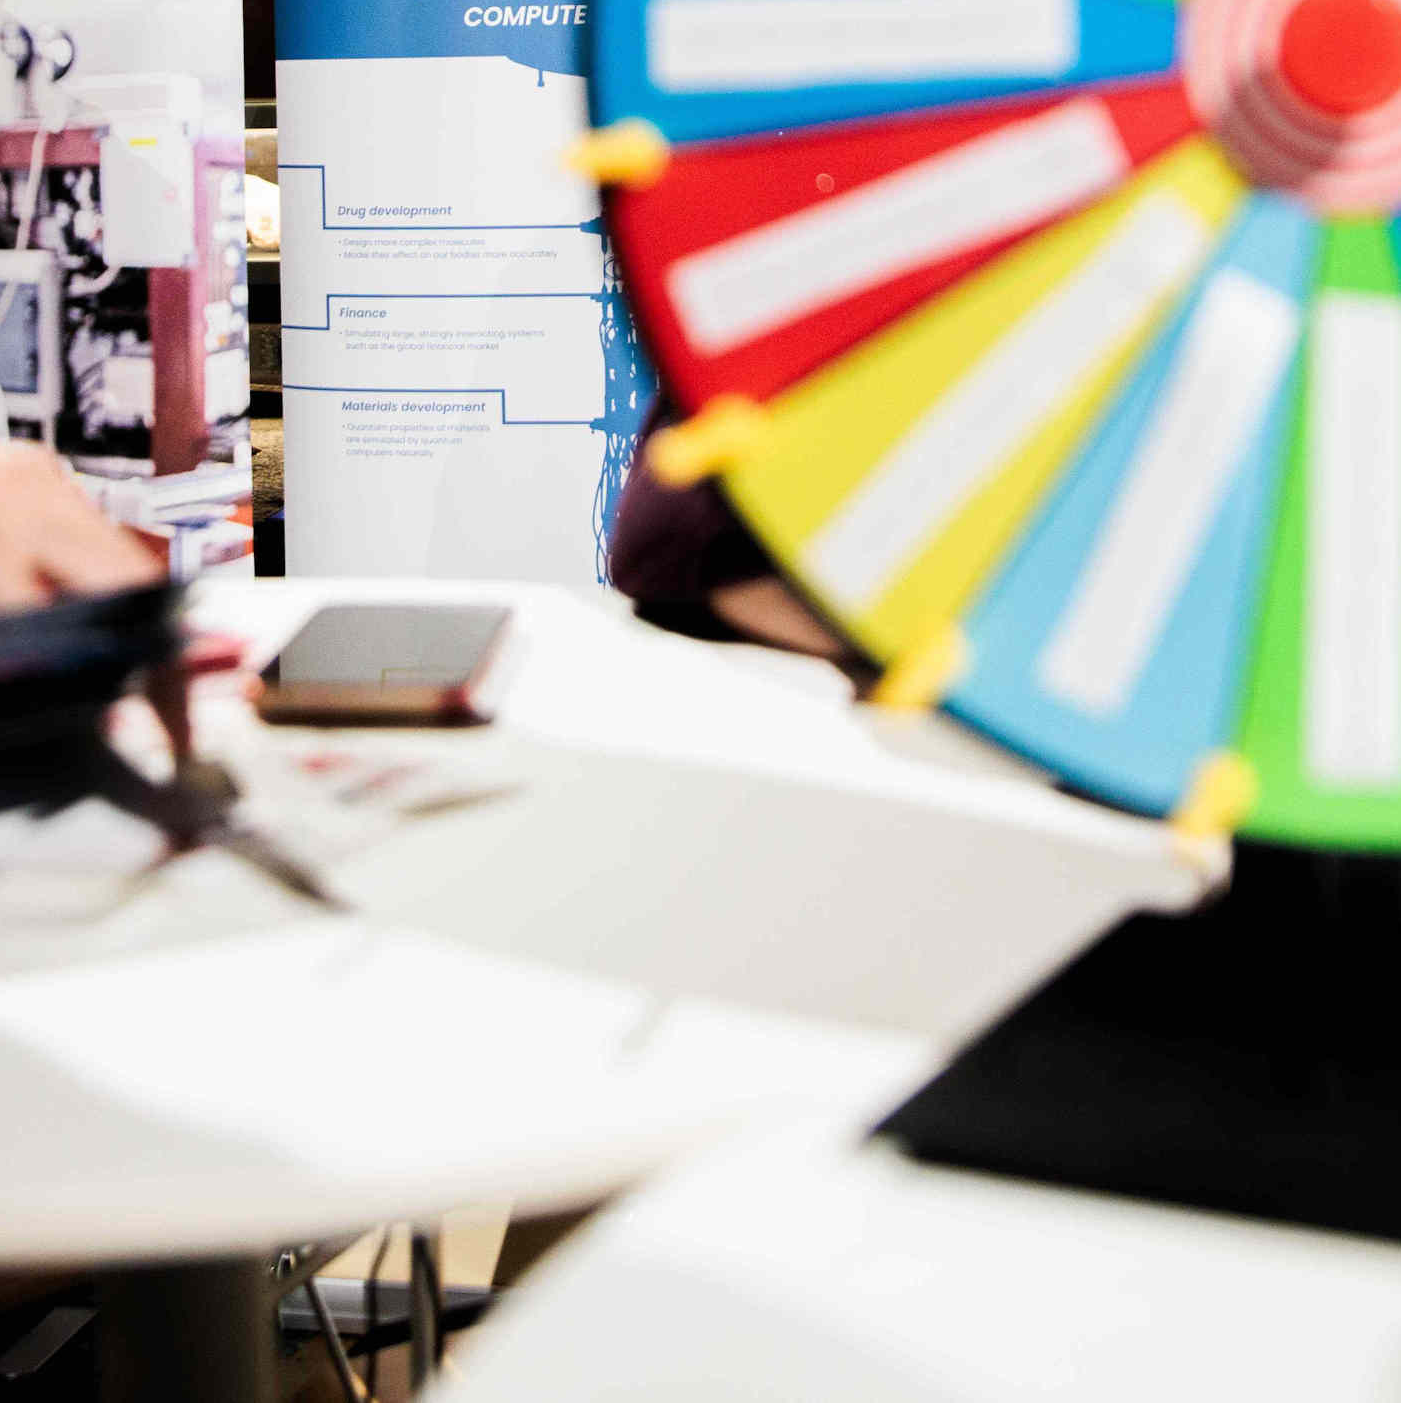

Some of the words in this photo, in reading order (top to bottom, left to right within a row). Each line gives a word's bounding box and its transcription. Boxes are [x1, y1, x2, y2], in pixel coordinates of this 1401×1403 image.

[337, 205, 366, 219] Drug
[369, 204, 452, 219] development
[339, 307, 387, 319] Finance
[341, 401, 398, 412] Materials
[401, 401, 486, 414] development
